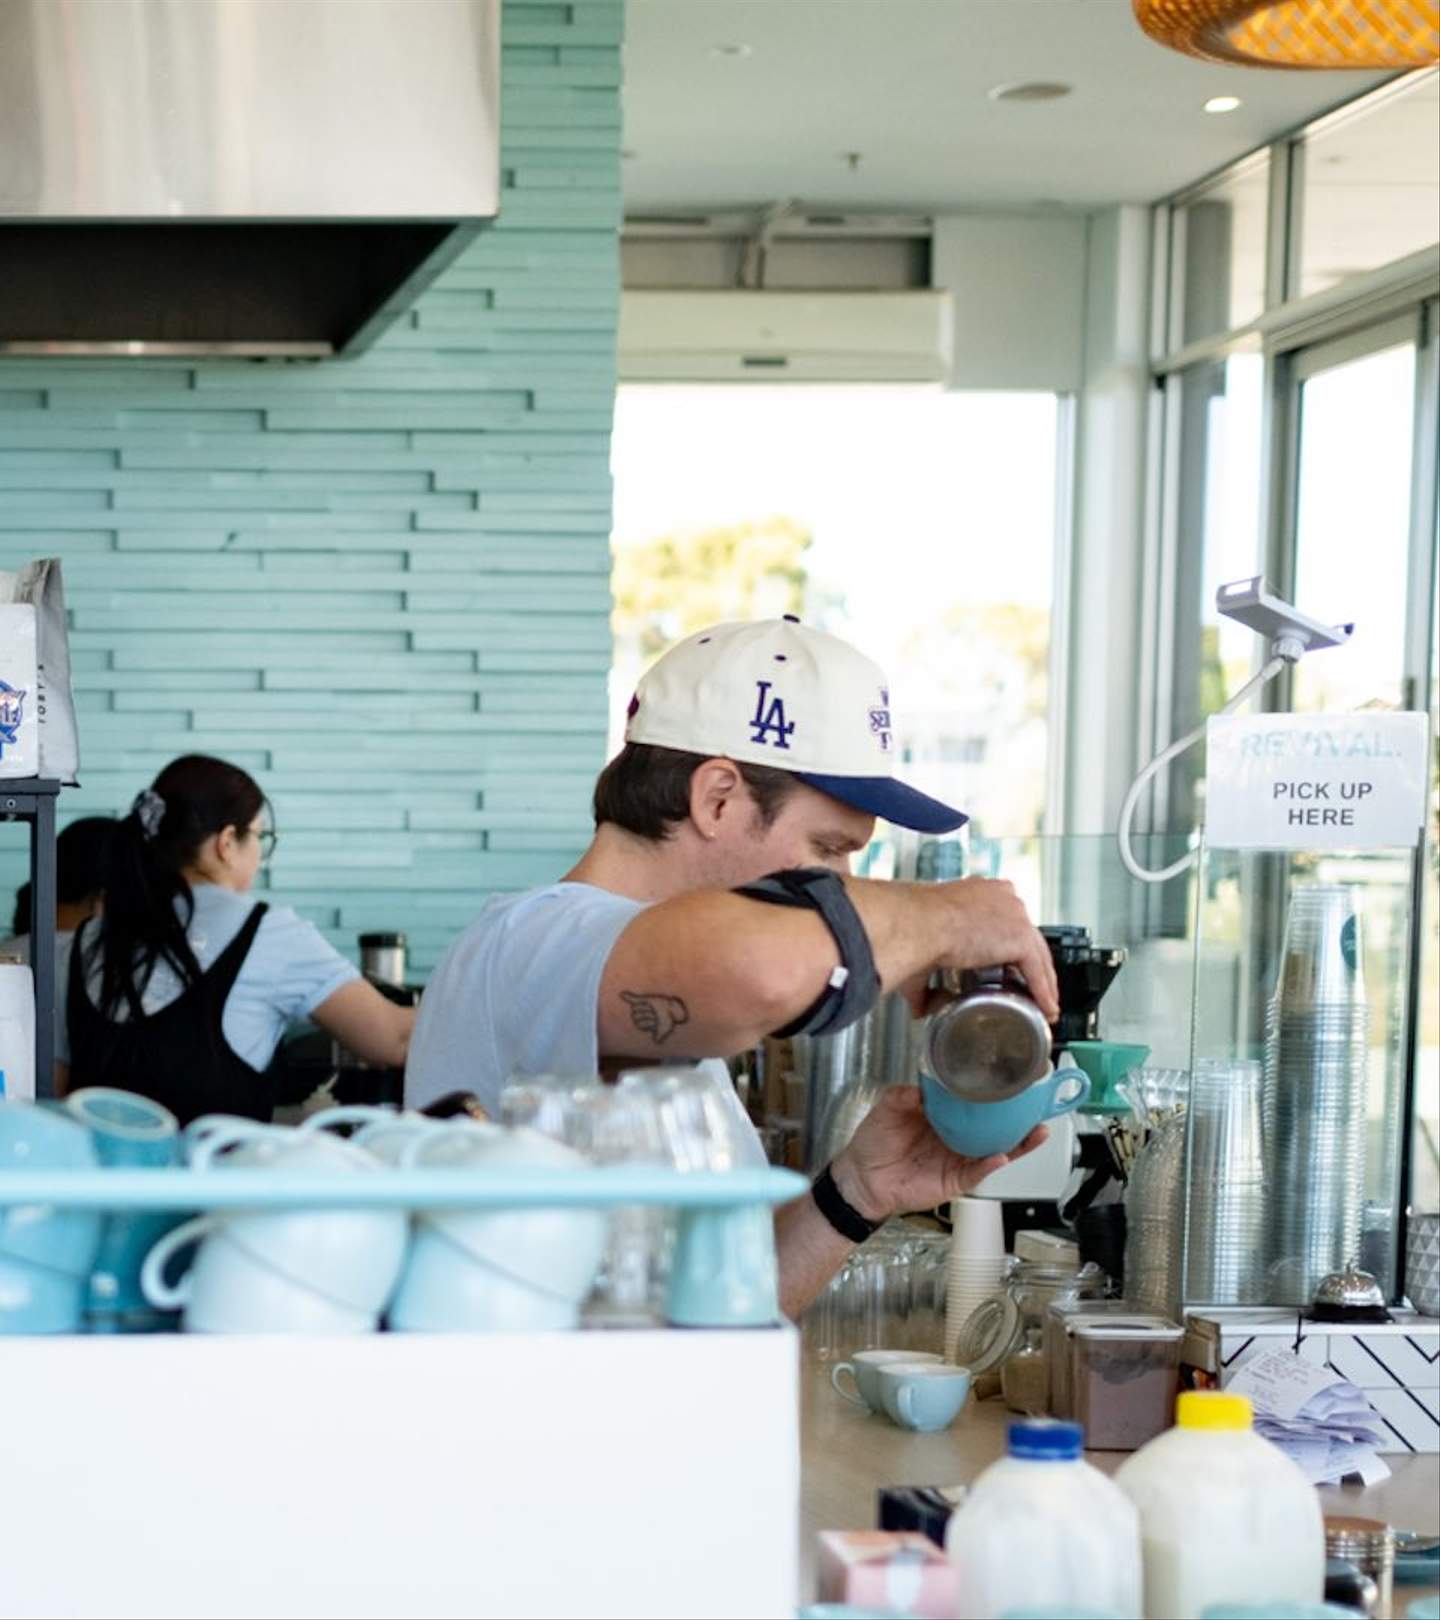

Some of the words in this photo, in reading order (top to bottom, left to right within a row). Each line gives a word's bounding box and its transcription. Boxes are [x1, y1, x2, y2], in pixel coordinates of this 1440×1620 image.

[749, 680, 795, 749] LA
[1273, 782, 1330, 799] PICK
[1340, 782, 1372, 799] UP
[1288, 808, 1354, 825] HERE
